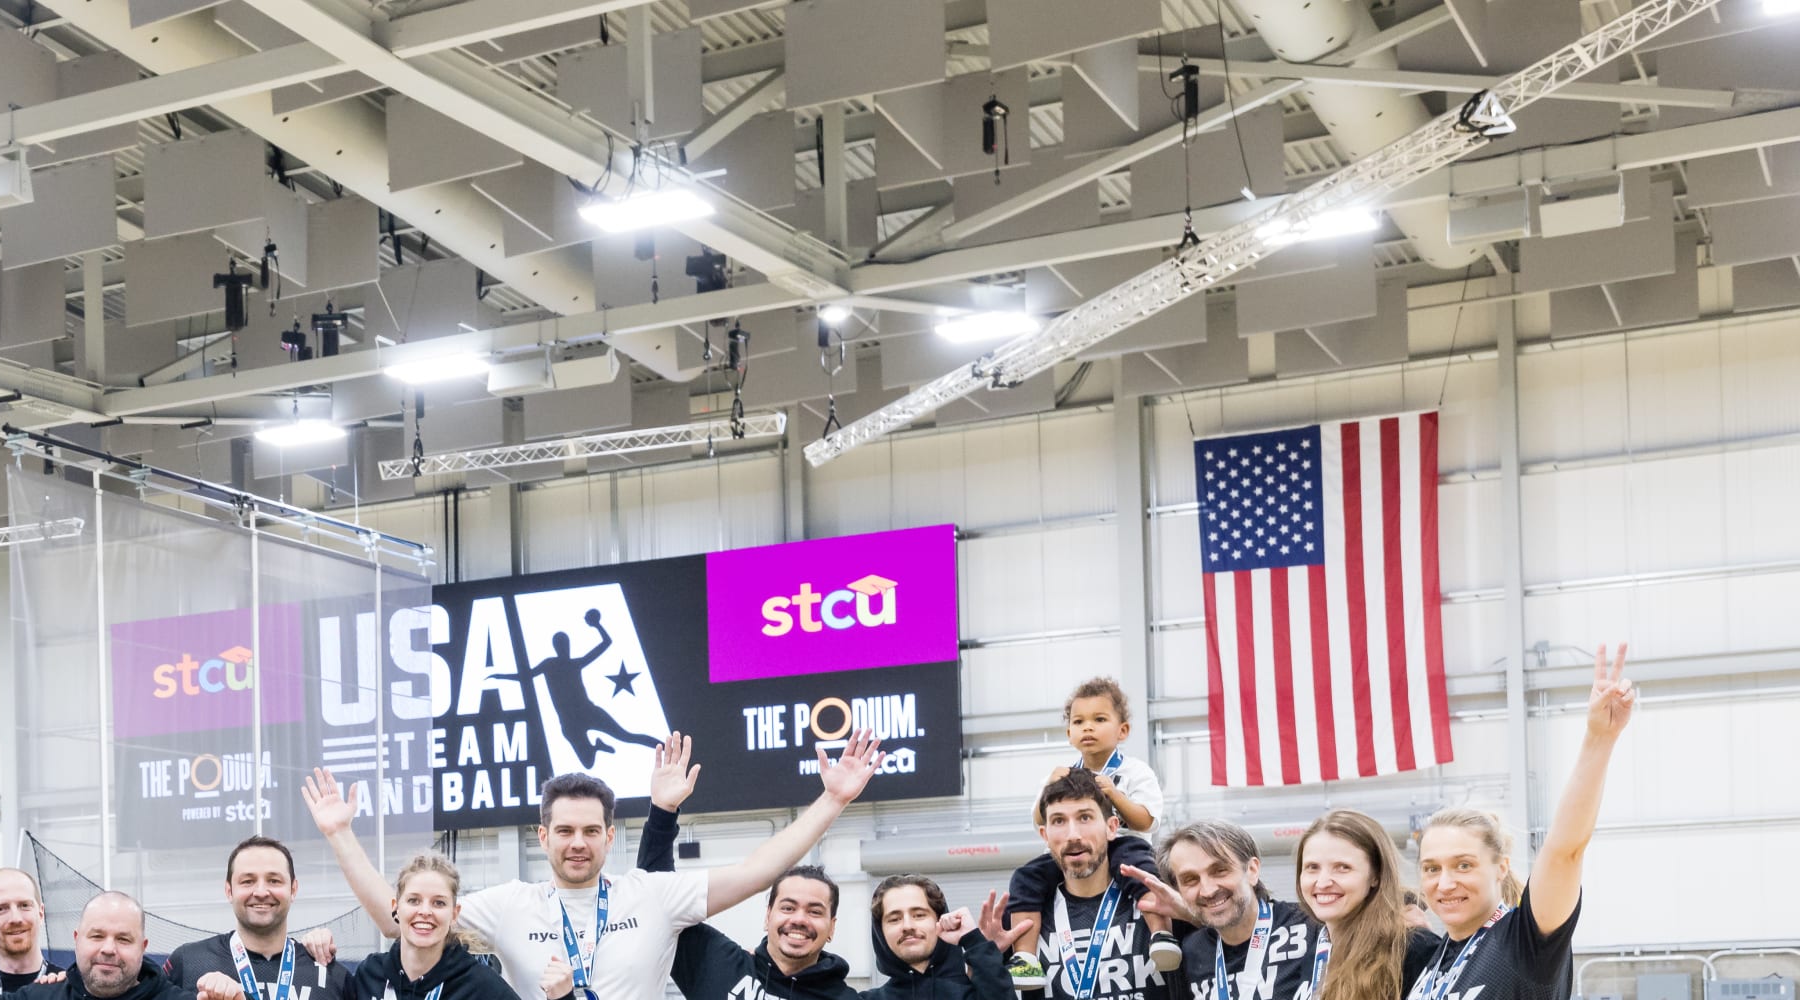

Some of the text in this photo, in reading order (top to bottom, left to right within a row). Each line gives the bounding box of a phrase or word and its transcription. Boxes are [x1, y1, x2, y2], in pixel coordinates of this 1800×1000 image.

[761, 582, 897, 636] stcu
[153, 652, 254, 698] stcu
[319, 596, 526, 726] USA
[743, 694, 924, 750] THE PODIUM.
[394, 721, 528, 771] TEAM
[870, 749, 916, 774] tcu
[139, 760, 172, 798] THE
[335, 766, 546, 818] ANDBALL
[529, 930, 558, 942] nyc
[1037, 923, 1136, 962] NEW
[1250, 935, 1260, 949] USA
[1268, 923, 1307, 963] 23
